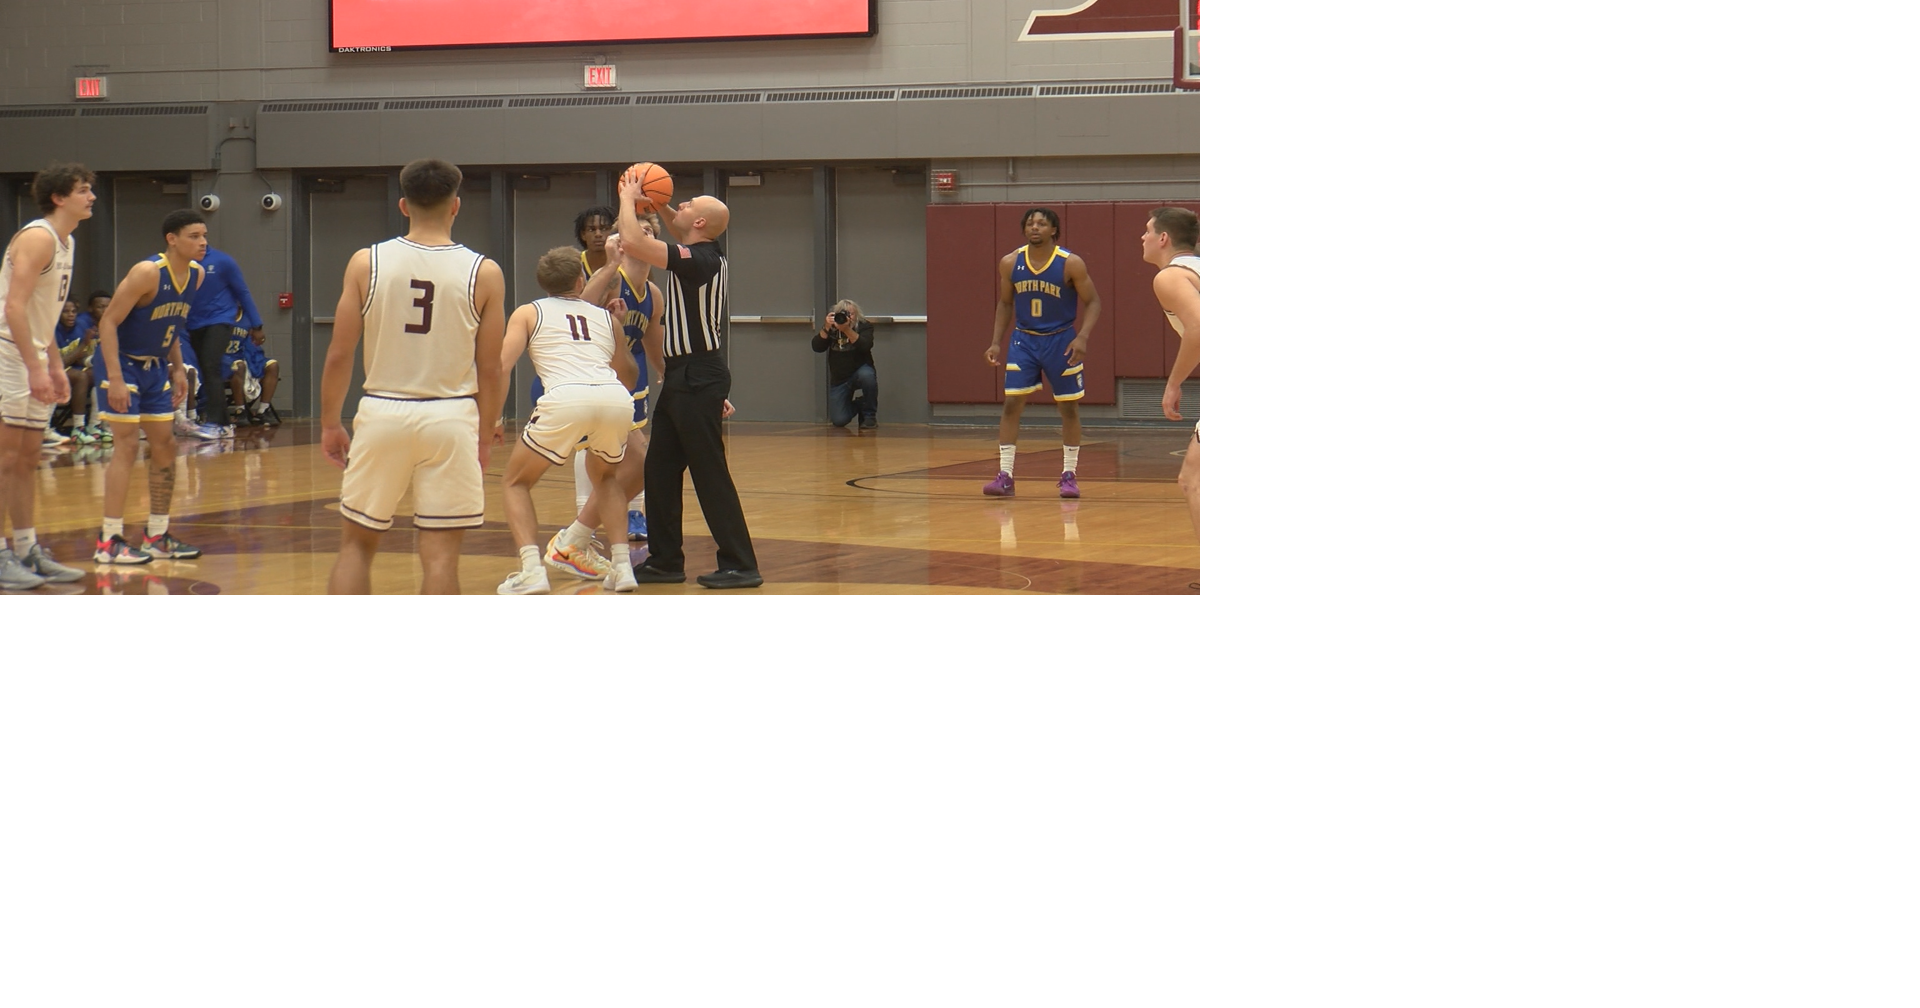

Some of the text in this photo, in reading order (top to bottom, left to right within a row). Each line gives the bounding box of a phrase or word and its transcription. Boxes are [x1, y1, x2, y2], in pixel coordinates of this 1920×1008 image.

[588, 67, 611, 86] EXIT
[79, 79, 99, 96] EXIT
[1039, 280, 1061, 299] PARK
[405, 279, 434, 335] 3
[1031, 298, 1042, 317] 0
[162, 324, 176, 348] 5
[565, 313, 591, 341] 11
[225, 340, 240, 354] 23
